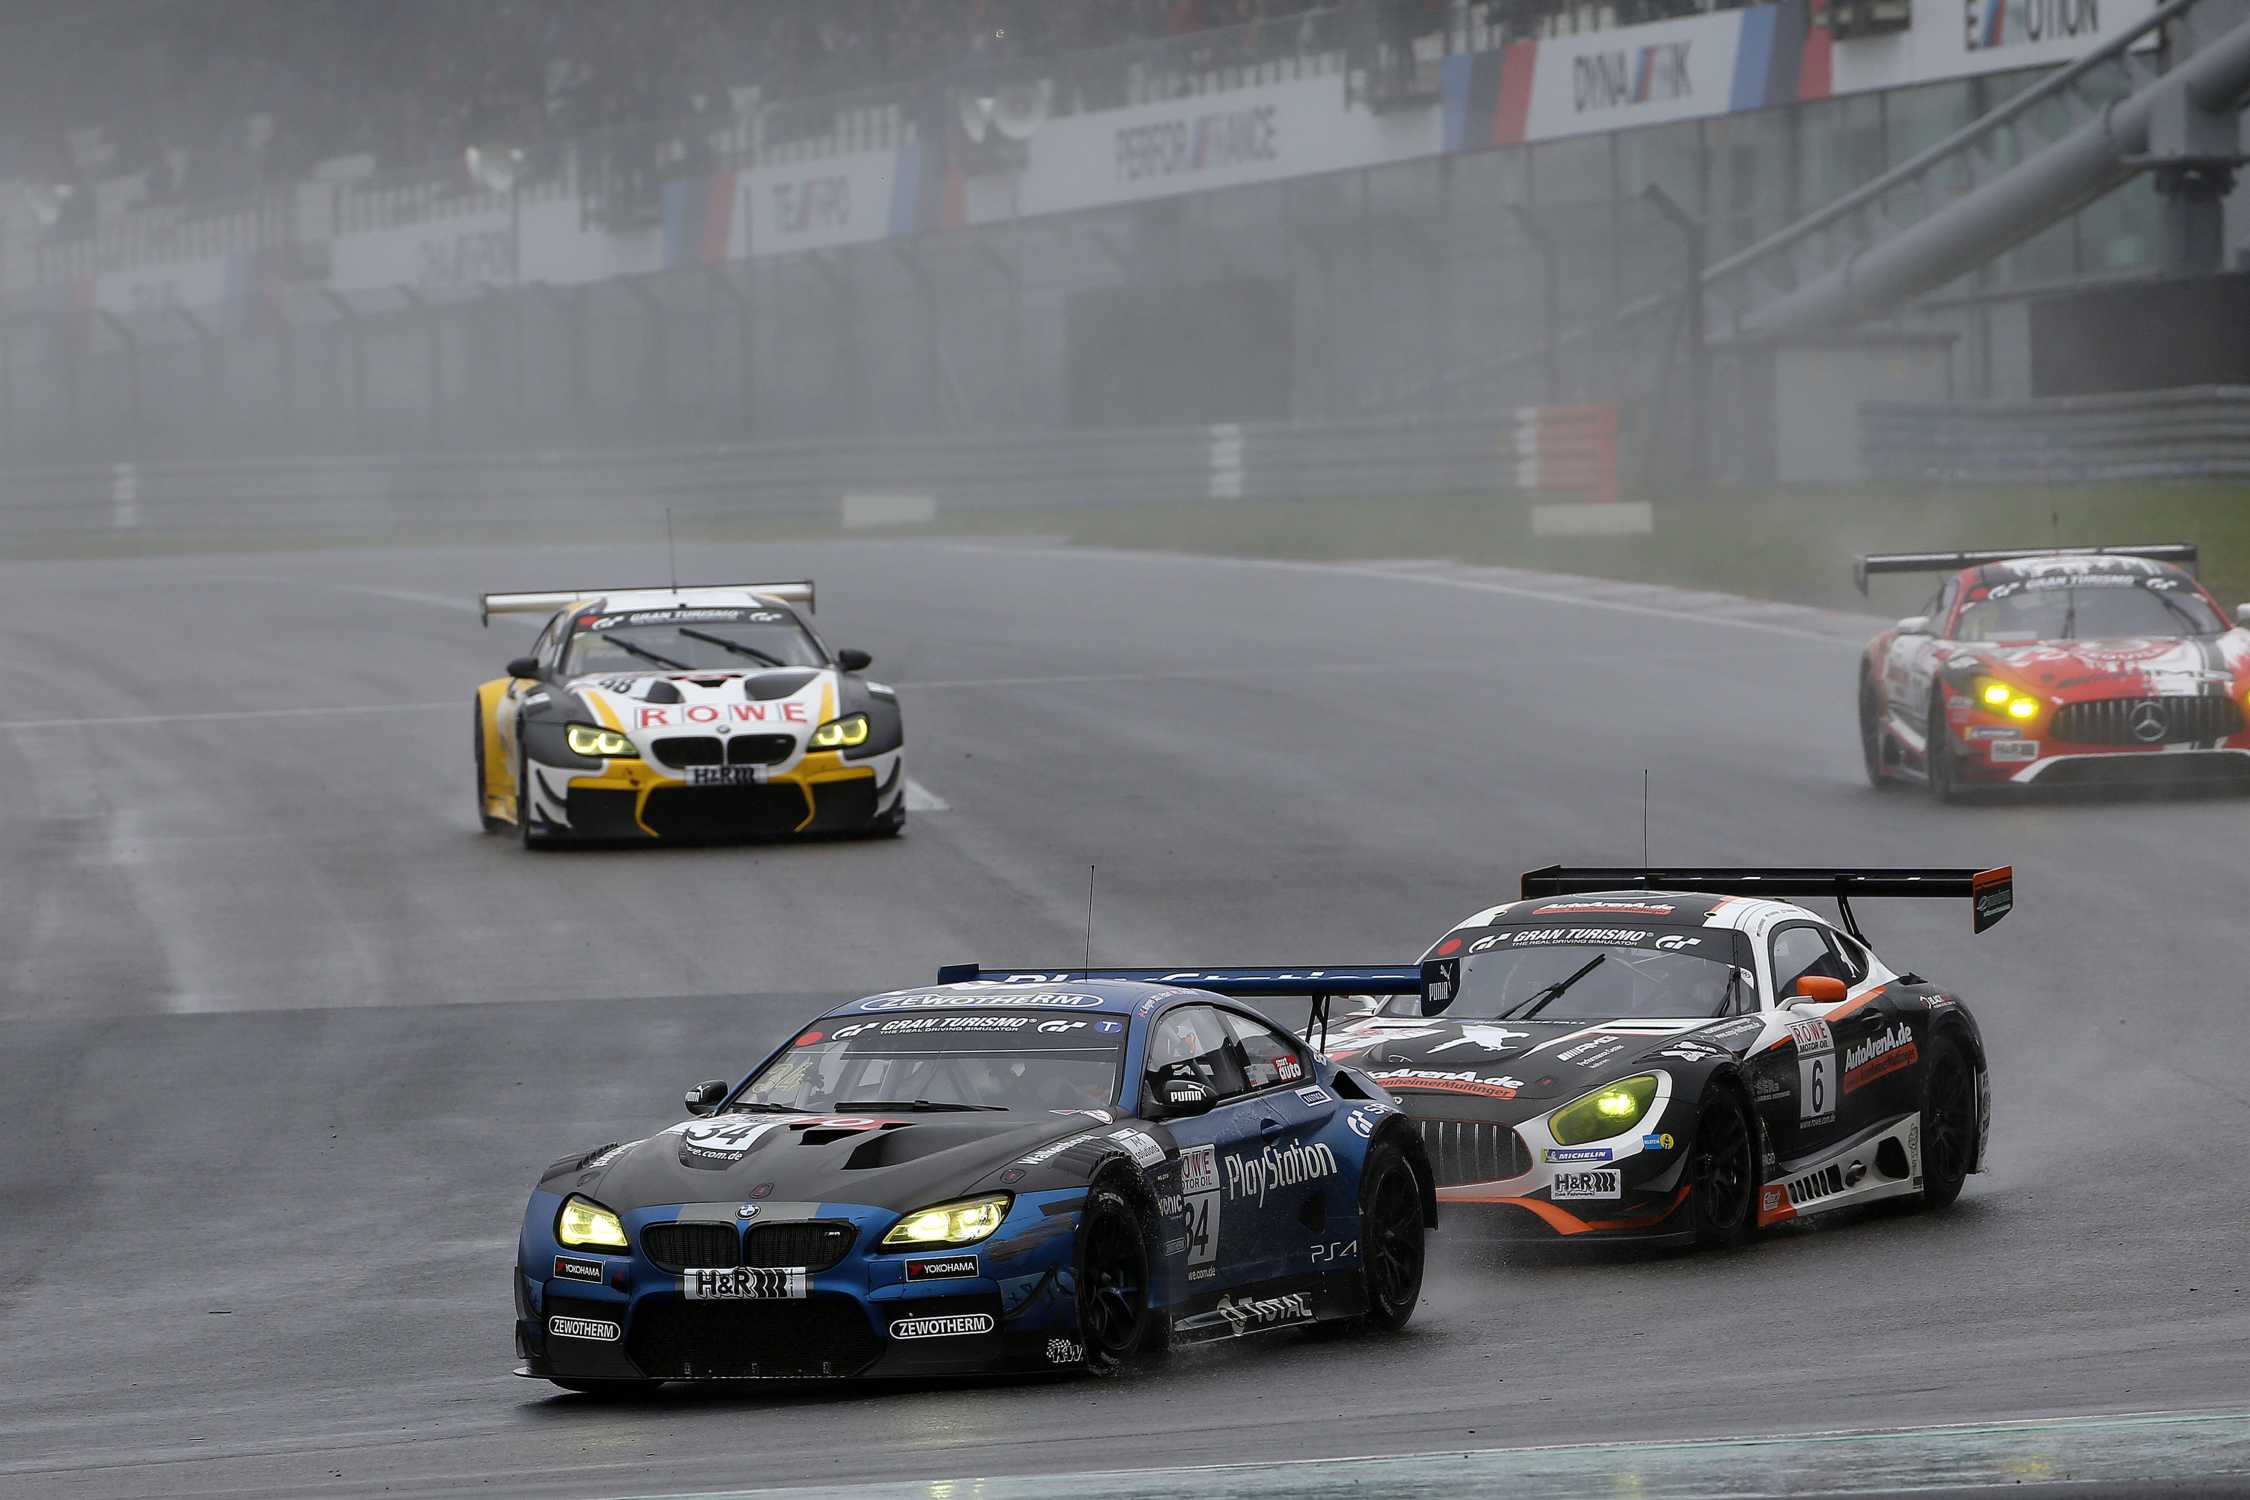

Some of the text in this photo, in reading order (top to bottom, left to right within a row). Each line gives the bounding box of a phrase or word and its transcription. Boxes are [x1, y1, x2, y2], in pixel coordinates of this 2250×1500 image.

[630, 612, 671, 623] GRAN
[676, 609, 739, 620] TURISMO
[640, 703, 808, 729] ROWE
[1512, 929, 1564, 942] GRAN
[1566, 928, 1647, 941] TURISMO
[882, 992, 1085, 1008] ZEWOTHERM
[880, 1018, 938, 1031] GRAN
[942, 1017, 1032, 1029] TURISMO
[1793, 1021, 1828, 1042] ROWE
[1800, 1039, 1829, 1050] MOTOR OIL
[1844, 1022, 1913, 1073] AutoArenA.de
[1278, 1063, 1302, 1080] auto
[1811, 1059, 1824, 1114] 6
[1170, 1091, 1202, 1102] PUMA
[686, 1123, 756, 1145] 34
[1559, 1151, 1606, 1160] MICHELIN
[1224, 1138, 1338, 1209] PlayStation
[1310, 1240, 1358, 1264] PS4
[565, 1263, 600, 1277] YOKOHAMA
[924, 1262, 975, 1275] YOKOHAMA
[553, 1319, 614, 1338] ZEWOTHERM
[898, 1317, 986, 1337] ZEWOTHERM
